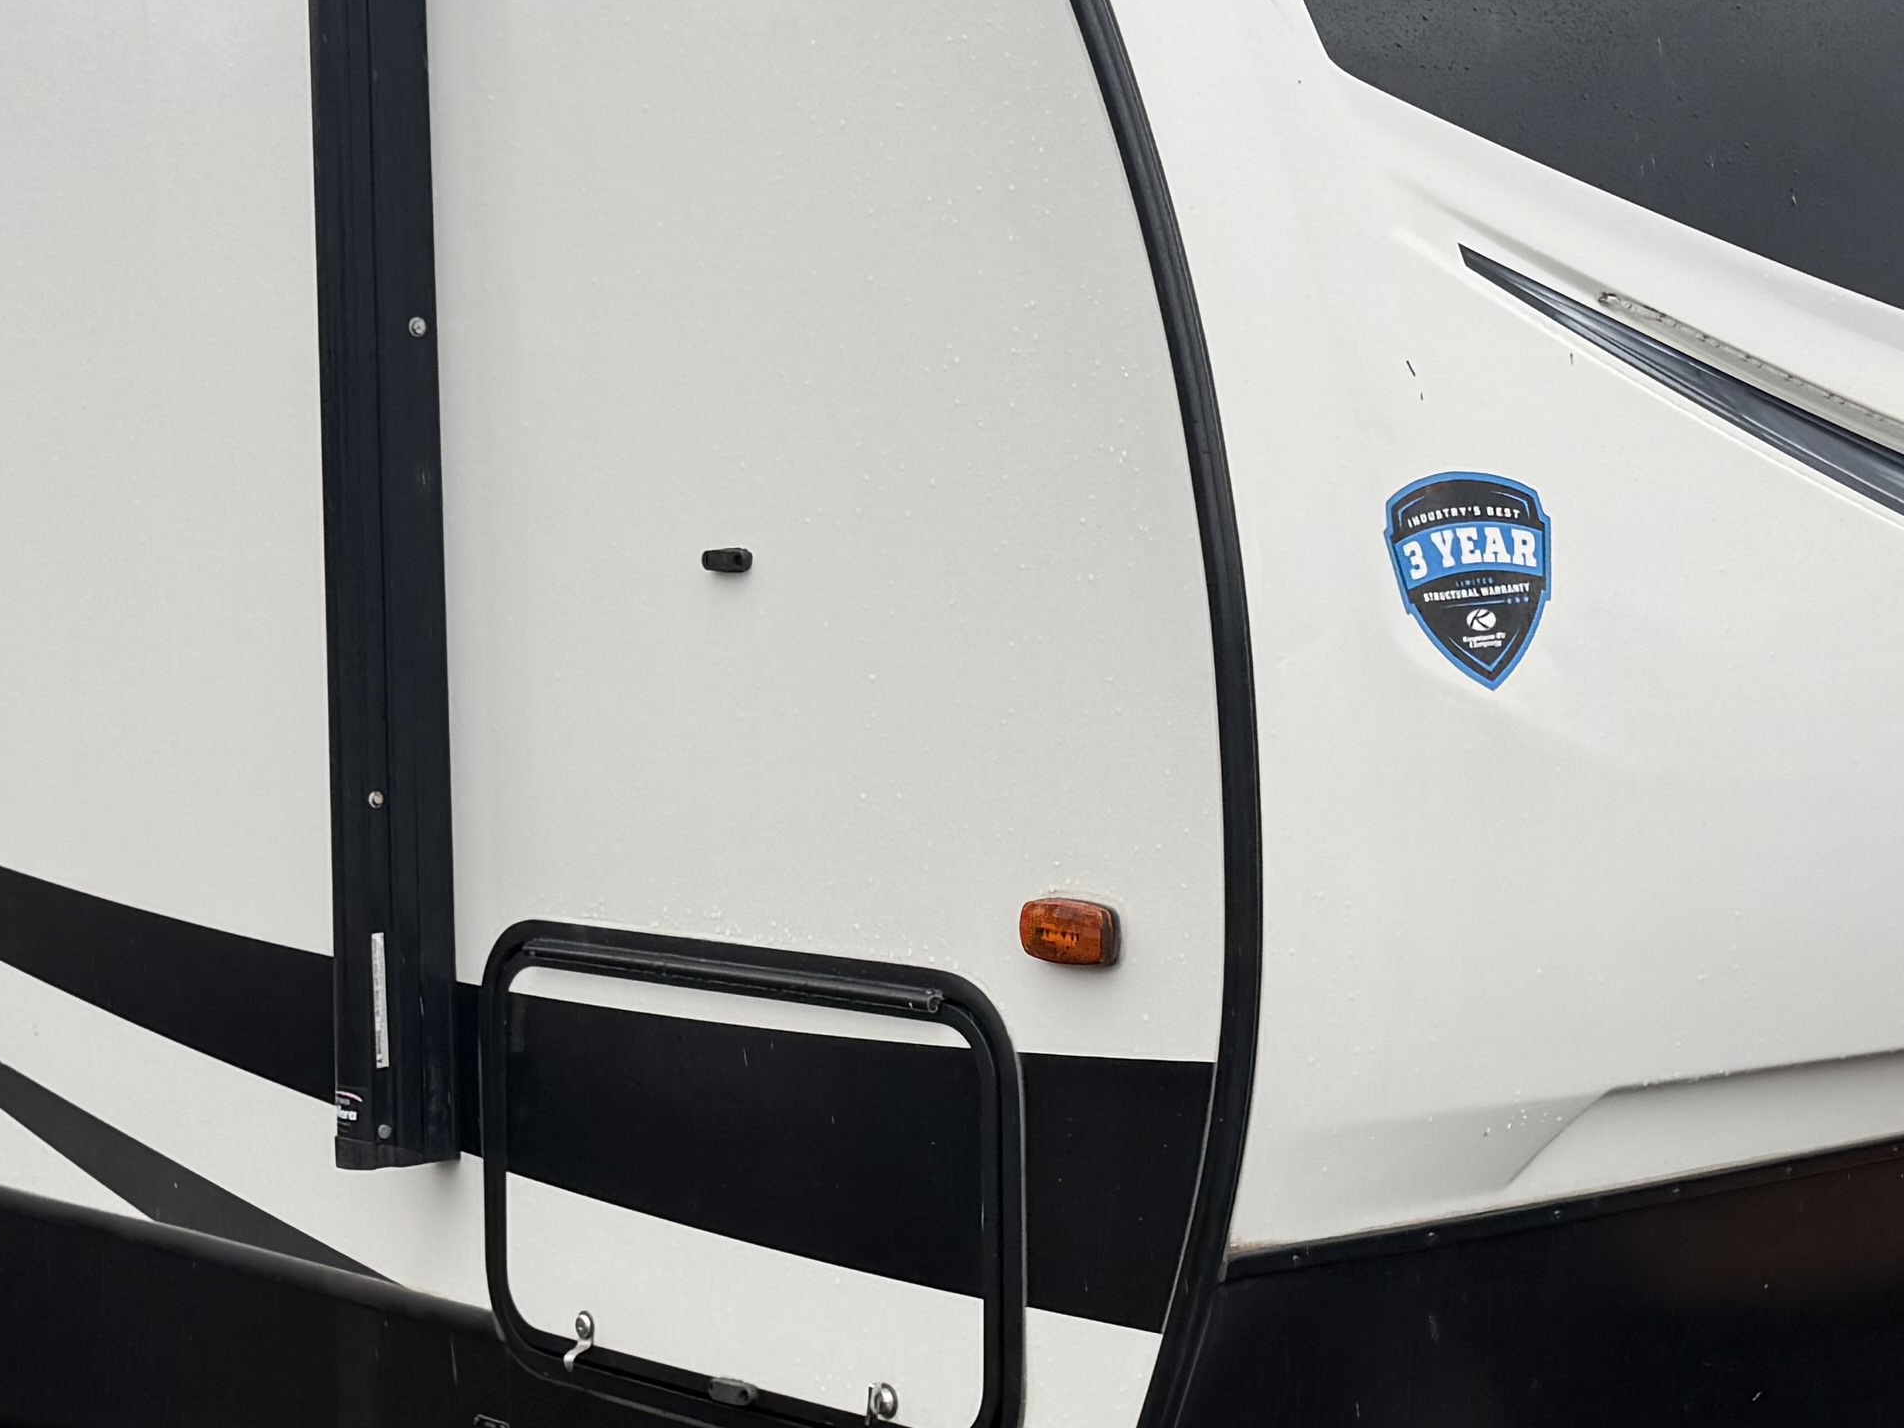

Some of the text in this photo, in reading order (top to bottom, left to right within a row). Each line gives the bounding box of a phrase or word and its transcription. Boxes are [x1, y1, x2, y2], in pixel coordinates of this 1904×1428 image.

[1408, 506, 1520, 528] INDUSTRY'S BEST
[1402, 526, 1538, 581] 3 YEAR
[1423, 582, 1529, 602] STRUCTURAL WARRANTY
